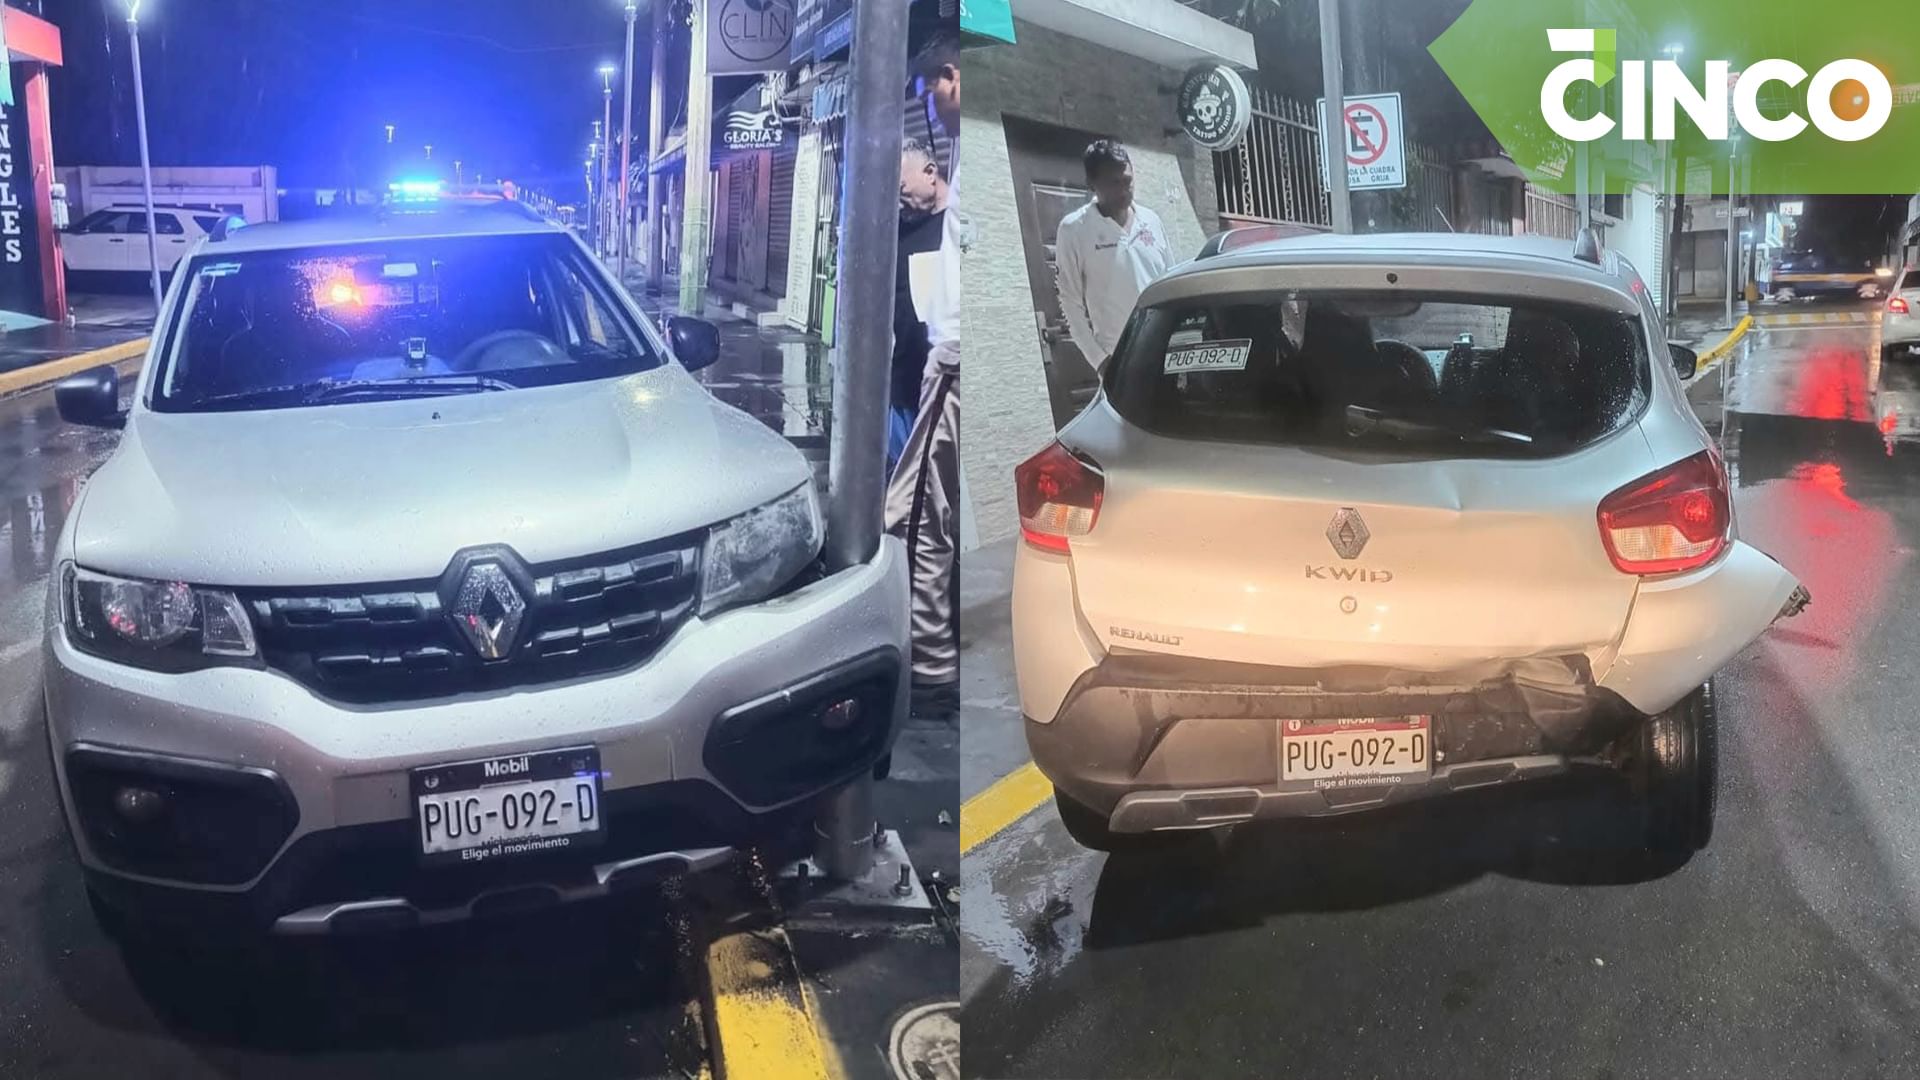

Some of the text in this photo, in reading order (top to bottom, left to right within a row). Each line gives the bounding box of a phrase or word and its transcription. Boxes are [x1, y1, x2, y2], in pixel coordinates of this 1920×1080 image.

[723, 128, 783, 143] GLORIA'S
[1369, 165, 1395, 174] CUADRA
[1168, 348, 1241, 367] PUG-092-D
[1305, 565, 1393, 583] KWID
[1109, 625, 1184, 646] RENAULT
[1287, 733, 1424, 773] PUG-092-D
[484, 757, 530, 777] Mobil
[1313, 779, 1336, 790] Elige
[1338, 778, 1347, 787] el
[1348, 775, 1402, 786] movimiento
[424, 783, 595, 843] PUG-092-D
[462, 836, 570, 861] Elige el movimiento
